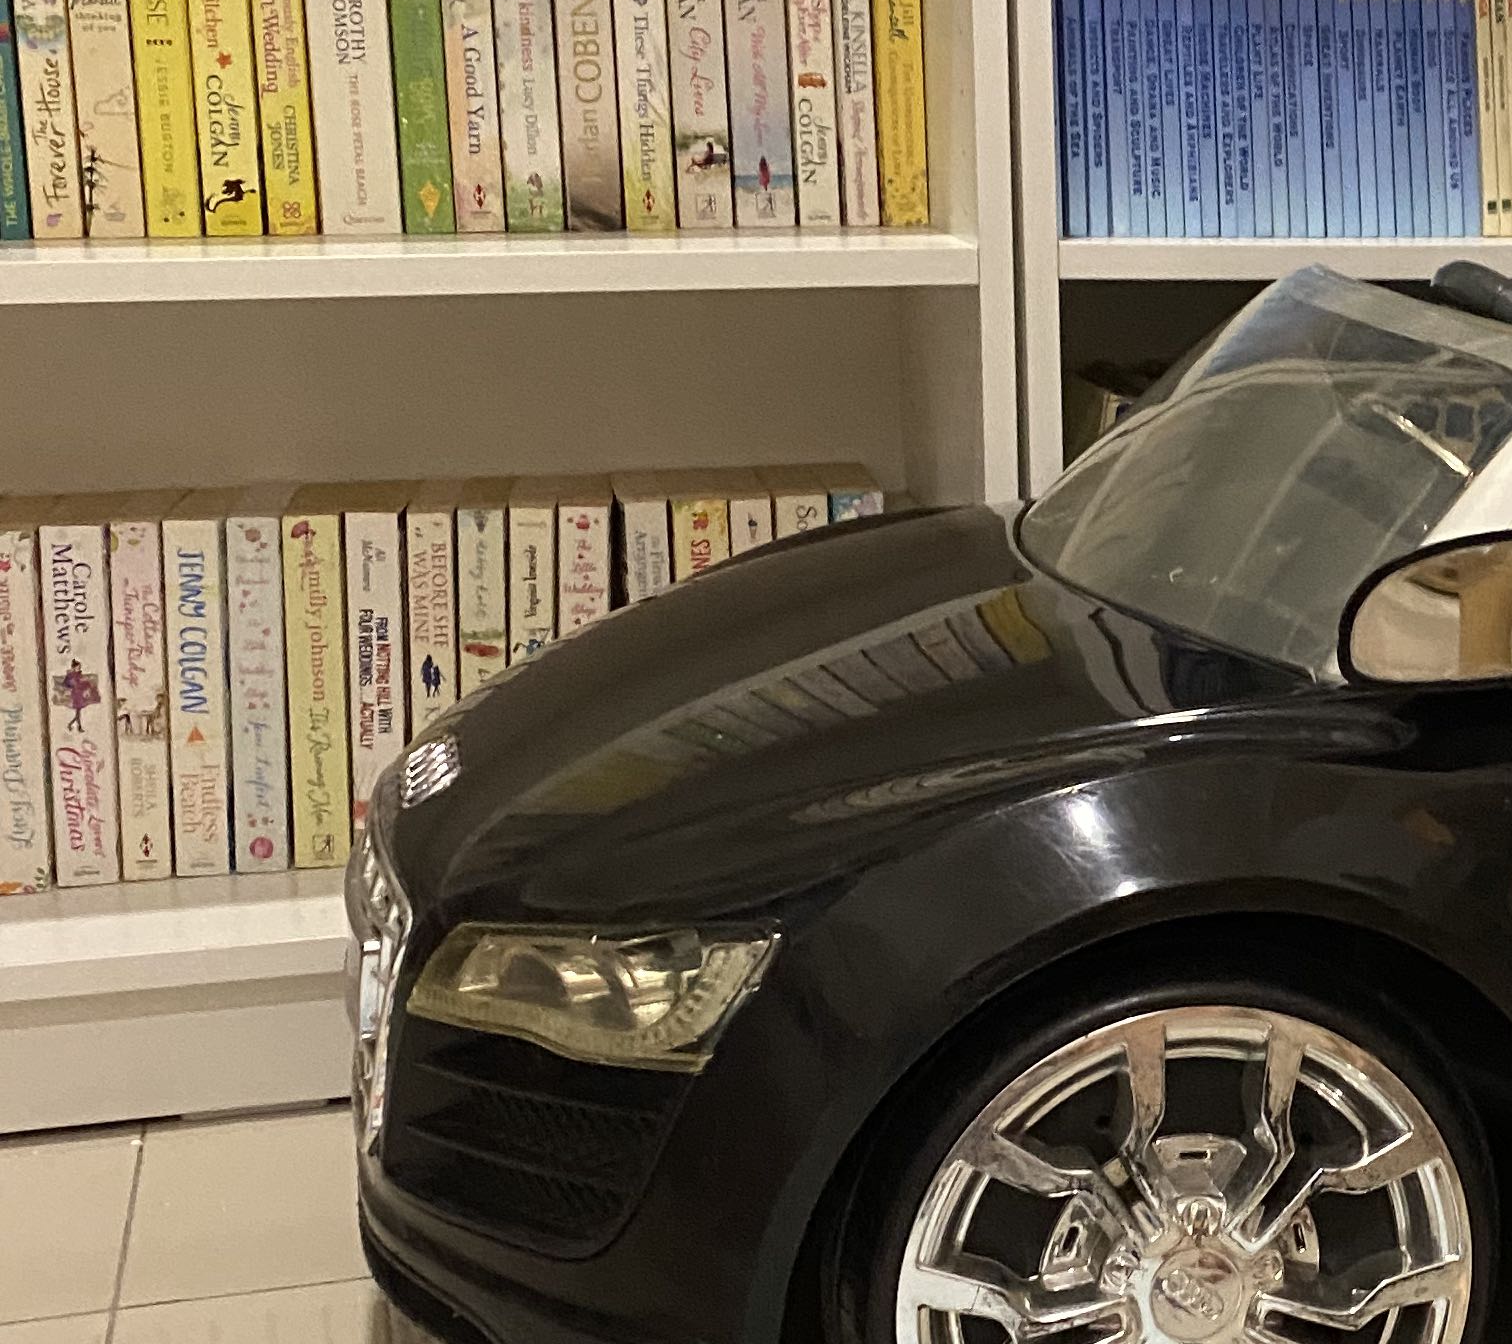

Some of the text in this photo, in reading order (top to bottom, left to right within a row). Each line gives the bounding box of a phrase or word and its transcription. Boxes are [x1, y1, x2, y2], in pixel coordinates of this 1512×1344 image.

[260, 14, 280, 94] Wedding
[283, 37, 301, 88] English
[518, 1, 537, 71] kindness
[680, 26, 714, 117] City Lives
[850, 11, 869, 93] KINSELLA
[205, 74, 230, 168] COLGAN
[223, 95, 245, 147] Jenny
[461, 24, 484, 156] A Good Yarn
[520, 78, 541, 156] Lucy Dillon
[633, 13, 657, 181] These Things Hidden
[35, 58, 71, 202] Forever House
[160, 113, 175, 174] BURTON
[267, 122, 285, 170] JONES
[282, 105, 300, 186] CHRISTINA
[797, 99, 818, 186] COLGAN
[1070, 131, 1080, 157] SEA
[1131, 119, 1143, 195] SCULPTURE
[1187, 123, 1199, 202] AMPHIBIANS
[1223, 133, 1234, 205] EXPLORERS
[1239, 145, 1249, 191] WORLD
[355, 168, 368, 205] BEACH
[52, 544, 80, 655] Matthews
[72, 562, 95, 634] Carole
[116, 588, 139, 644] Juniper
[411, 551, 429, 643] WAS MINE
[431, 542, 446, 612] BEFORE
[139, 603, 159, 655] Cottage
[178, 547, 210, 714] JENNY COLGAN
[305, 570, 328, 702] milly johnson
[357, 608, 374, 750] FOUR ACTUALLY
[375, 616, 393, 734] FROM NOTTING HILL WITH
[54, 747, 86, 853] Christmas
[130, 757, 146, 818] ROBERTS
[179, 773, 201, 835] Beach
[200, 764, 221, 843] Endless
